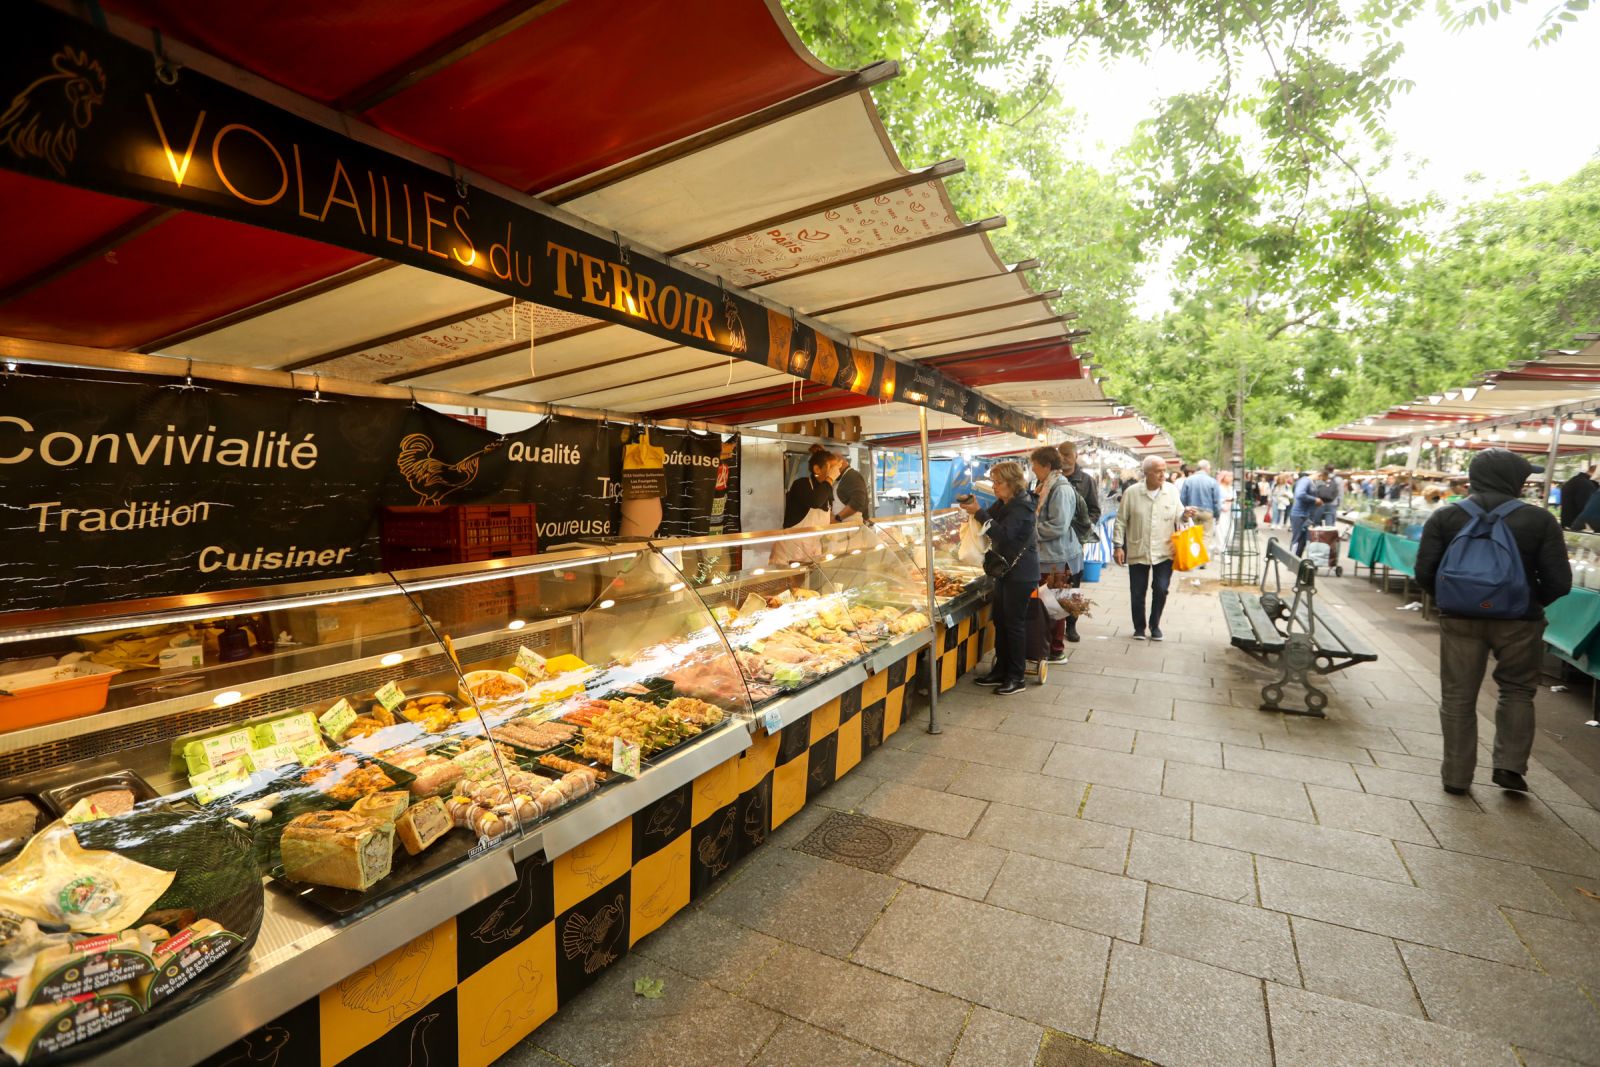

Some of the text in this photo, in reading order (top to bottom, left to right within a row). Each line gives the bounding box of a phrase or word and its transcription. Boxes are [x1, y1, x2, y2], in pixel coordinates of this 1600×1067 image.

[145, 92, 716, 342] VOLAILLES du TERROIR
[766, 229, 803, 254] PARIS
[421, 335, 460, 351] PARIS
[0, 416, 318, 470] Convivialité
[508, 441, 581, 465] Qualité
[663, 450, 720, 468] oûteuse
[29, 500, 210, 533] Tradition
[536, 518, 611, 538] voureuse
[198, 545, 352, 573] Cuisiner
[169, 973, 186, 985] Gras
